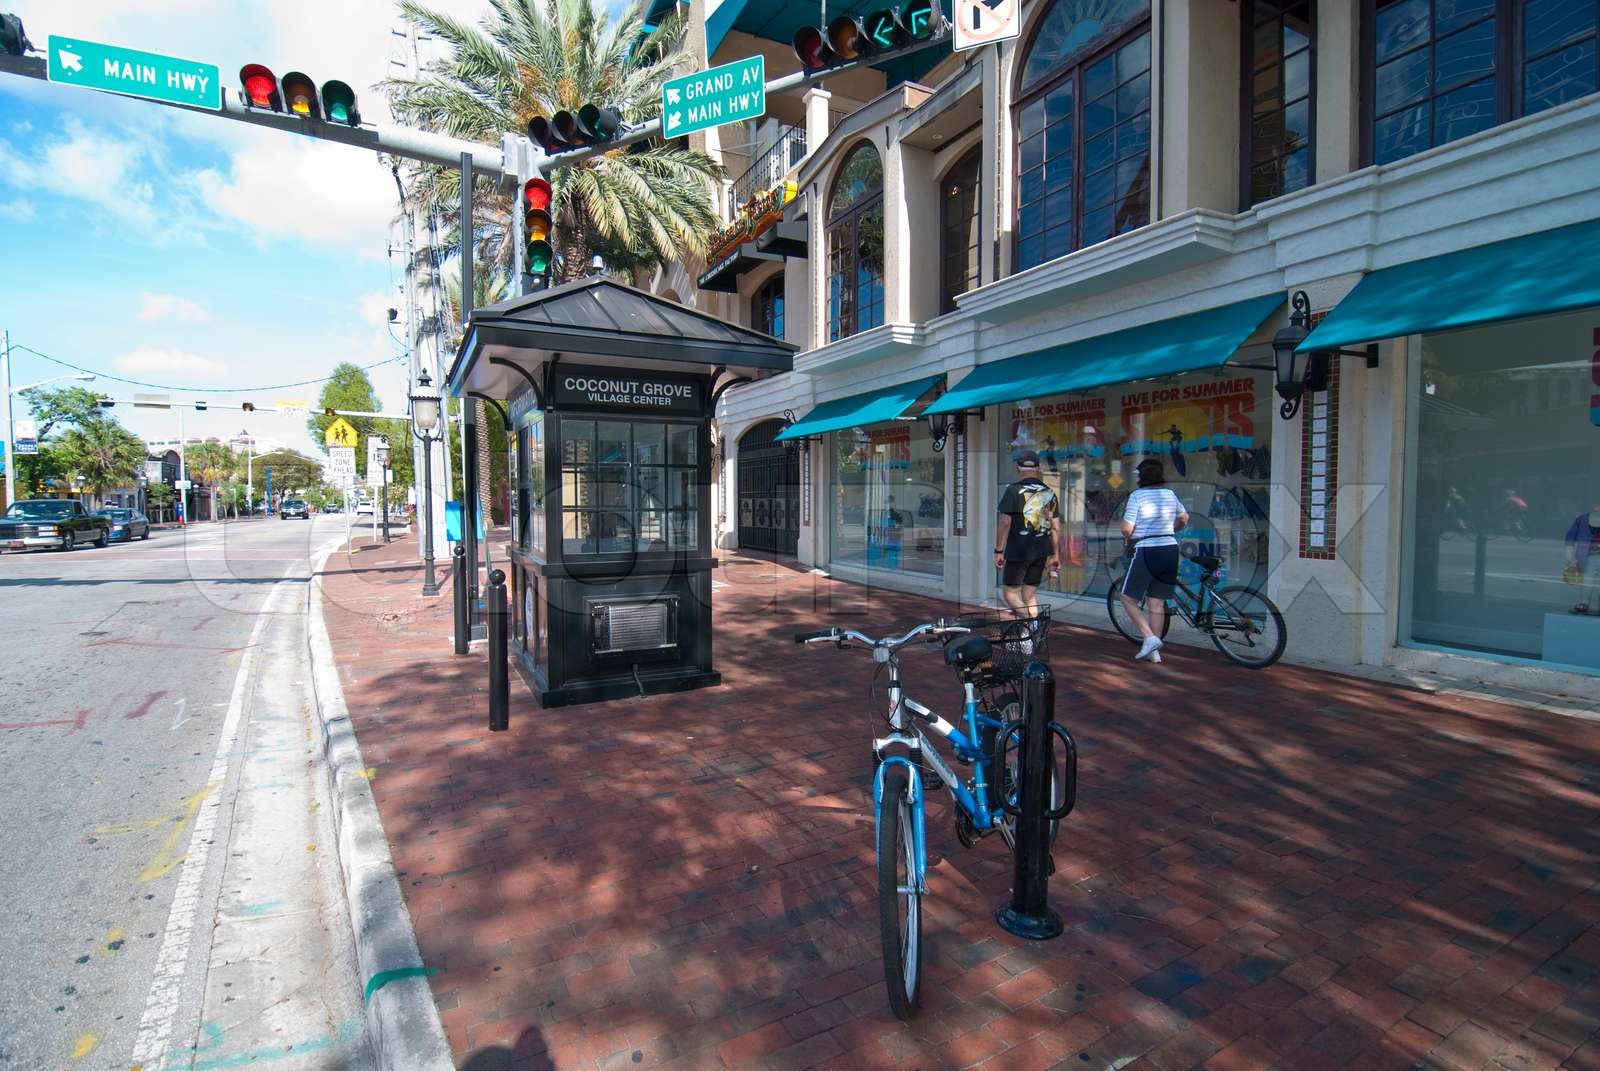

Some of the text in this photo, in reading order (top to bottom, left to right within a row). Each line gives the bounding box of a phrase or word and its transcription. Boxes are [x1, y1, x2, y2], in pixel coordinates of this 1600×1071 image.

[104, 58, 209, 94] MAIN HWY
[686, 65, 760, 99] GRAND AV
[688, 90, 760, 124] MAIN HWY
[564, 378, 692, 397] COCONUT GROVE
[588, 393, 672, 406] VILLAGE CENTER
[1121, 377, 1254, 406] LIVE FOR SUMMER
[1012, 398, 1105, 419] LIVE FOR SUMMER
